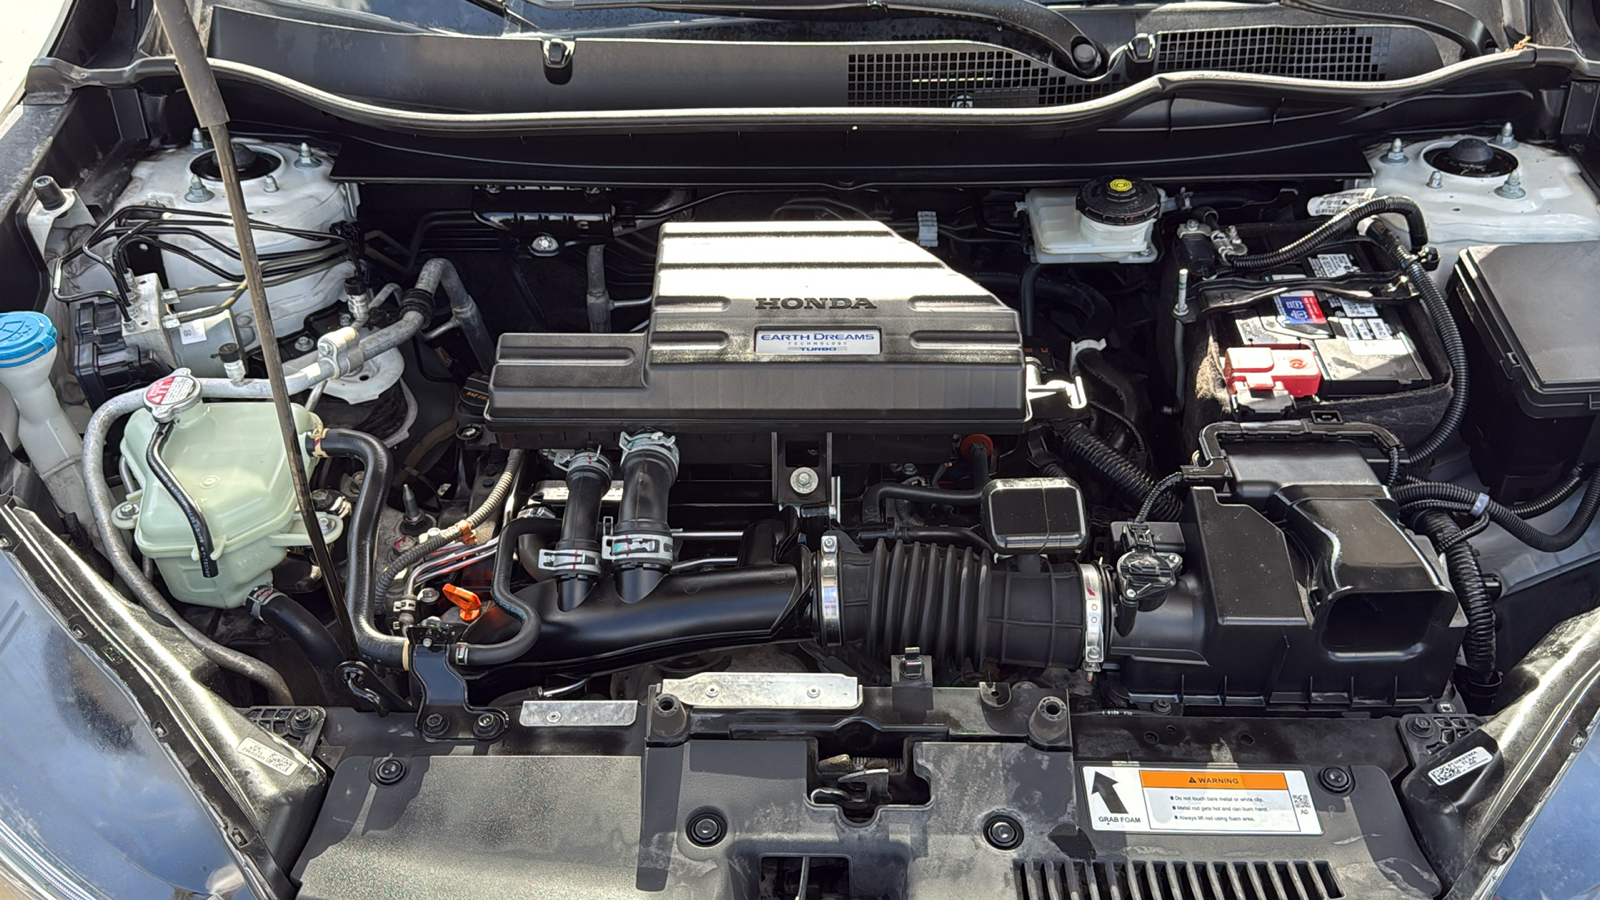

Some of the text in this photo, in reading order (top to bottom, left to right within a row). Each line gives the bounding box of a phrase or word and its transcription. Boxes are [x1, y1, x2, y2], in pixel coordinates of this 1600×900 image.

[755, 297, 878, 310] HONDA
[813, 333, 875, 341] DREAMS
[1198, 777, 1239, 785] WARNING
